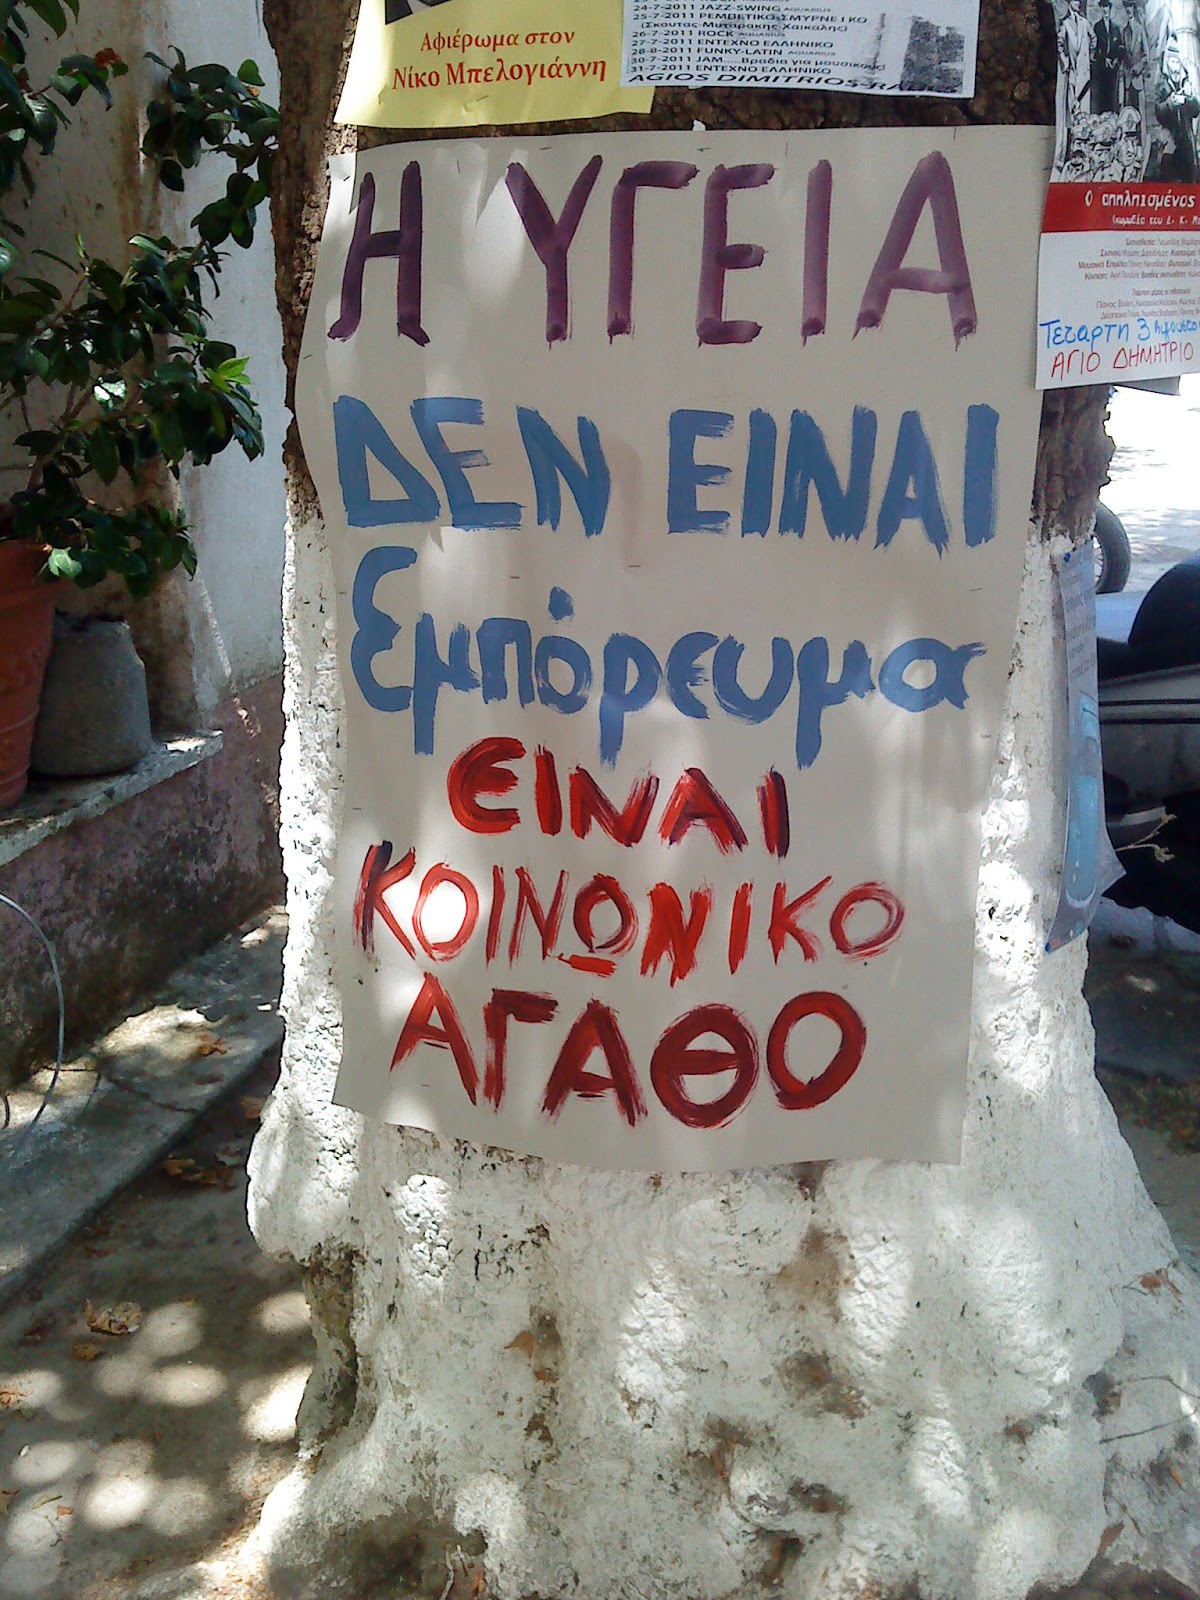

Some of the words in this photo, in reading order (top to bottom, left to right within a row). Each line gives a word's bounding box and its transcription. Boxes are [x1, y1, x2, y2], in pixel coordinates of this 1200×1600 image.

[420, 27, 519, 55] Αφιέρωμα
[524, 29, 576, 45] στον
[392, 66, 440, 90] Νίκο
[446, 55, 607, 85] Μπελογιάννη
[629, 73, 710, 83] AGIOS
[328, 159, 430, 347] Η
[505, 151, 977, 352] ΥΓΕΙΑ
[1138, 318, 1151, 341] 3
[1051, 349, 1101, 381] ΑΓΙΟ
[1113, 341, 1194, 369] ΔΗΜΗΤΡΙΟ
[333, 395, 612, 540] ΔΕΝ
[668, 404, 999, 558] ΕΙΝΑΙ
[447, 736, 790, 859] ΕΙΝΑΙ
[390, 972, 867, 1130] ΑΓΑΘΟ
